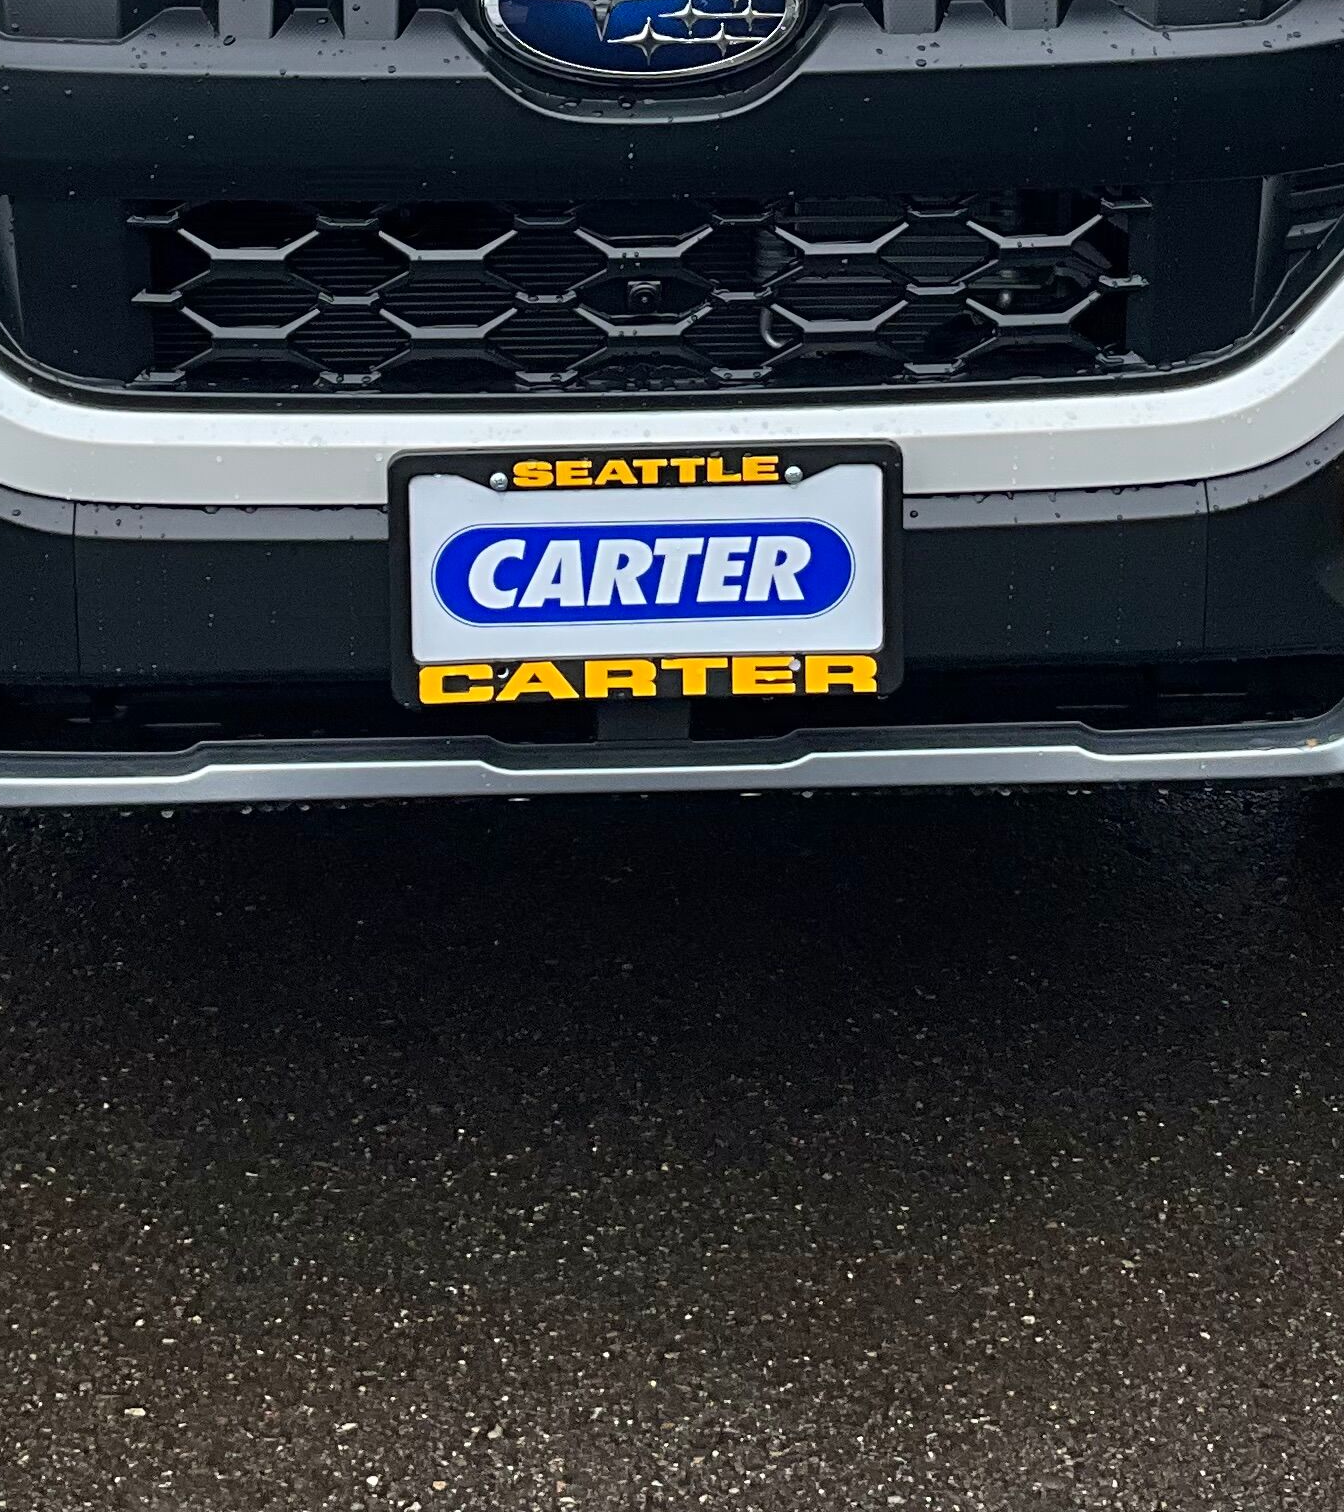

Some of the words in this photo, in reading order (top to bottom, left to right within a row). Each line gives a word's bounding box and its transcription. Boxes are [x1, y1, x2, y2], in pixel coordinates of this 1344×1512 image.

[512, 455, 780, 488] SEATTLE
[468, 535, 812, 610] CARTER
[418, 654, 879, 705] CARTER
